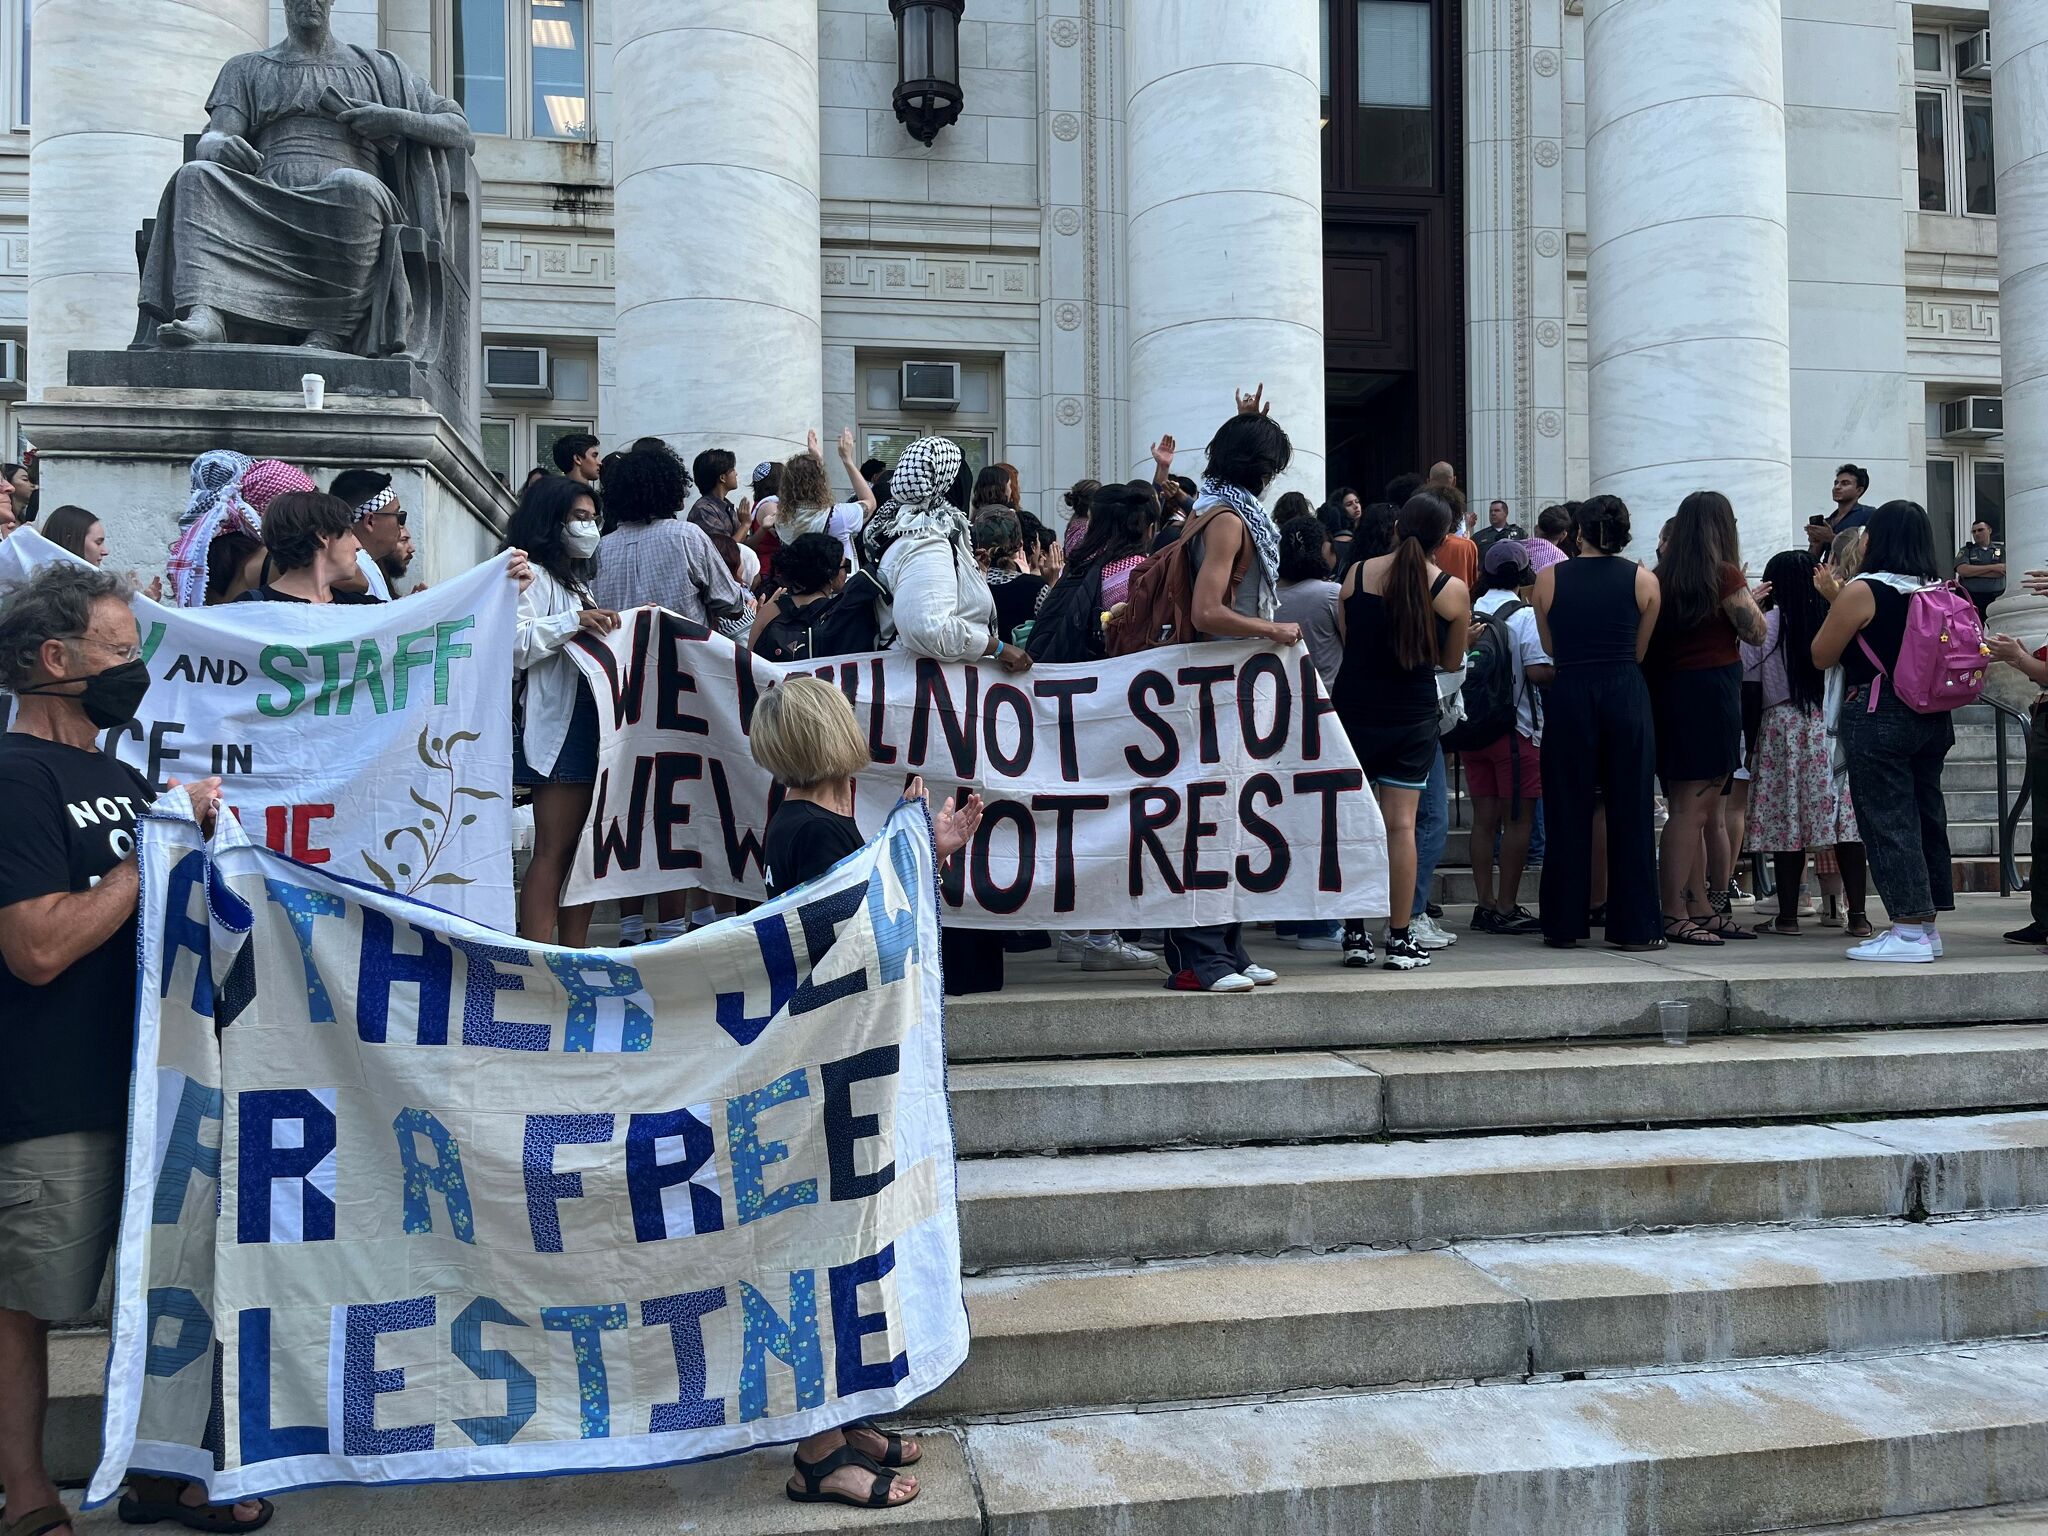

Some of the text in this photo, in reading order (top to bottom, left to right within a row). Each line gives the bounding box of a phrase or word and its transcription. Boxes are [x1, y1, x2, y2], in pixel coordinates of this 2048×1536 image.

[163, 615, 475, 717] AND STAFF
[571, 610, 711, 736] WE
[908, 658, 1098, 782] NOT
[67, 796, 137, 829] NOT
[211, 744, 253, 774] IN
[592, 752, 703, 880] WE
[1129, 769, 1363, 894] REST
[160, 829, 920, 1053] ATHER JEW
[152, 1043, 900, 1253] FR A FREE
[145, 1241, 910, 1471] PLESTINE
